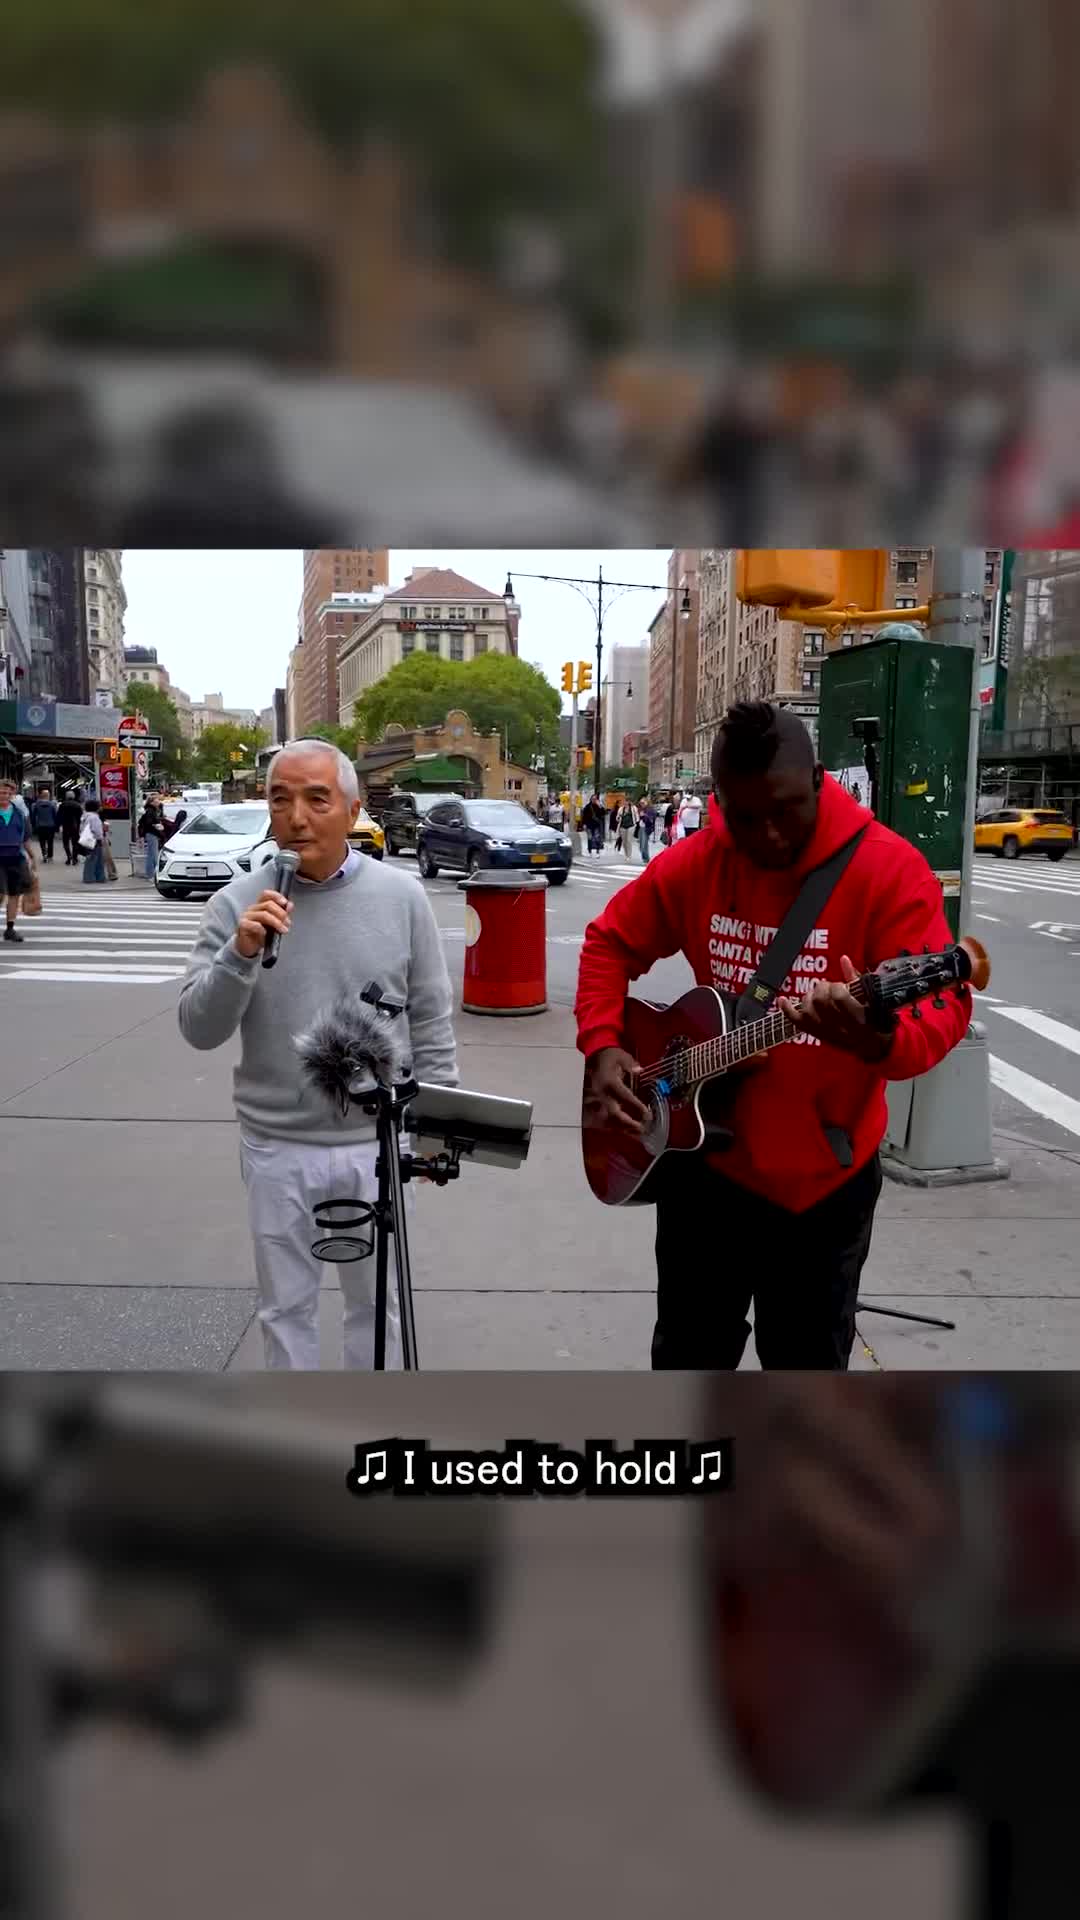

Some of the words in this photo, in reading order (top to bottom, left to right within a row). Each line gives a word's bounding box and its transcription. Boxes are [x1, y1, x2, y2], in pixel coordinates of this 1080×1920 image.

[710, 914, 752, 940] SING
[754, 924, 779, 946] WIT
[708, 938, 752, 964] CANTA
